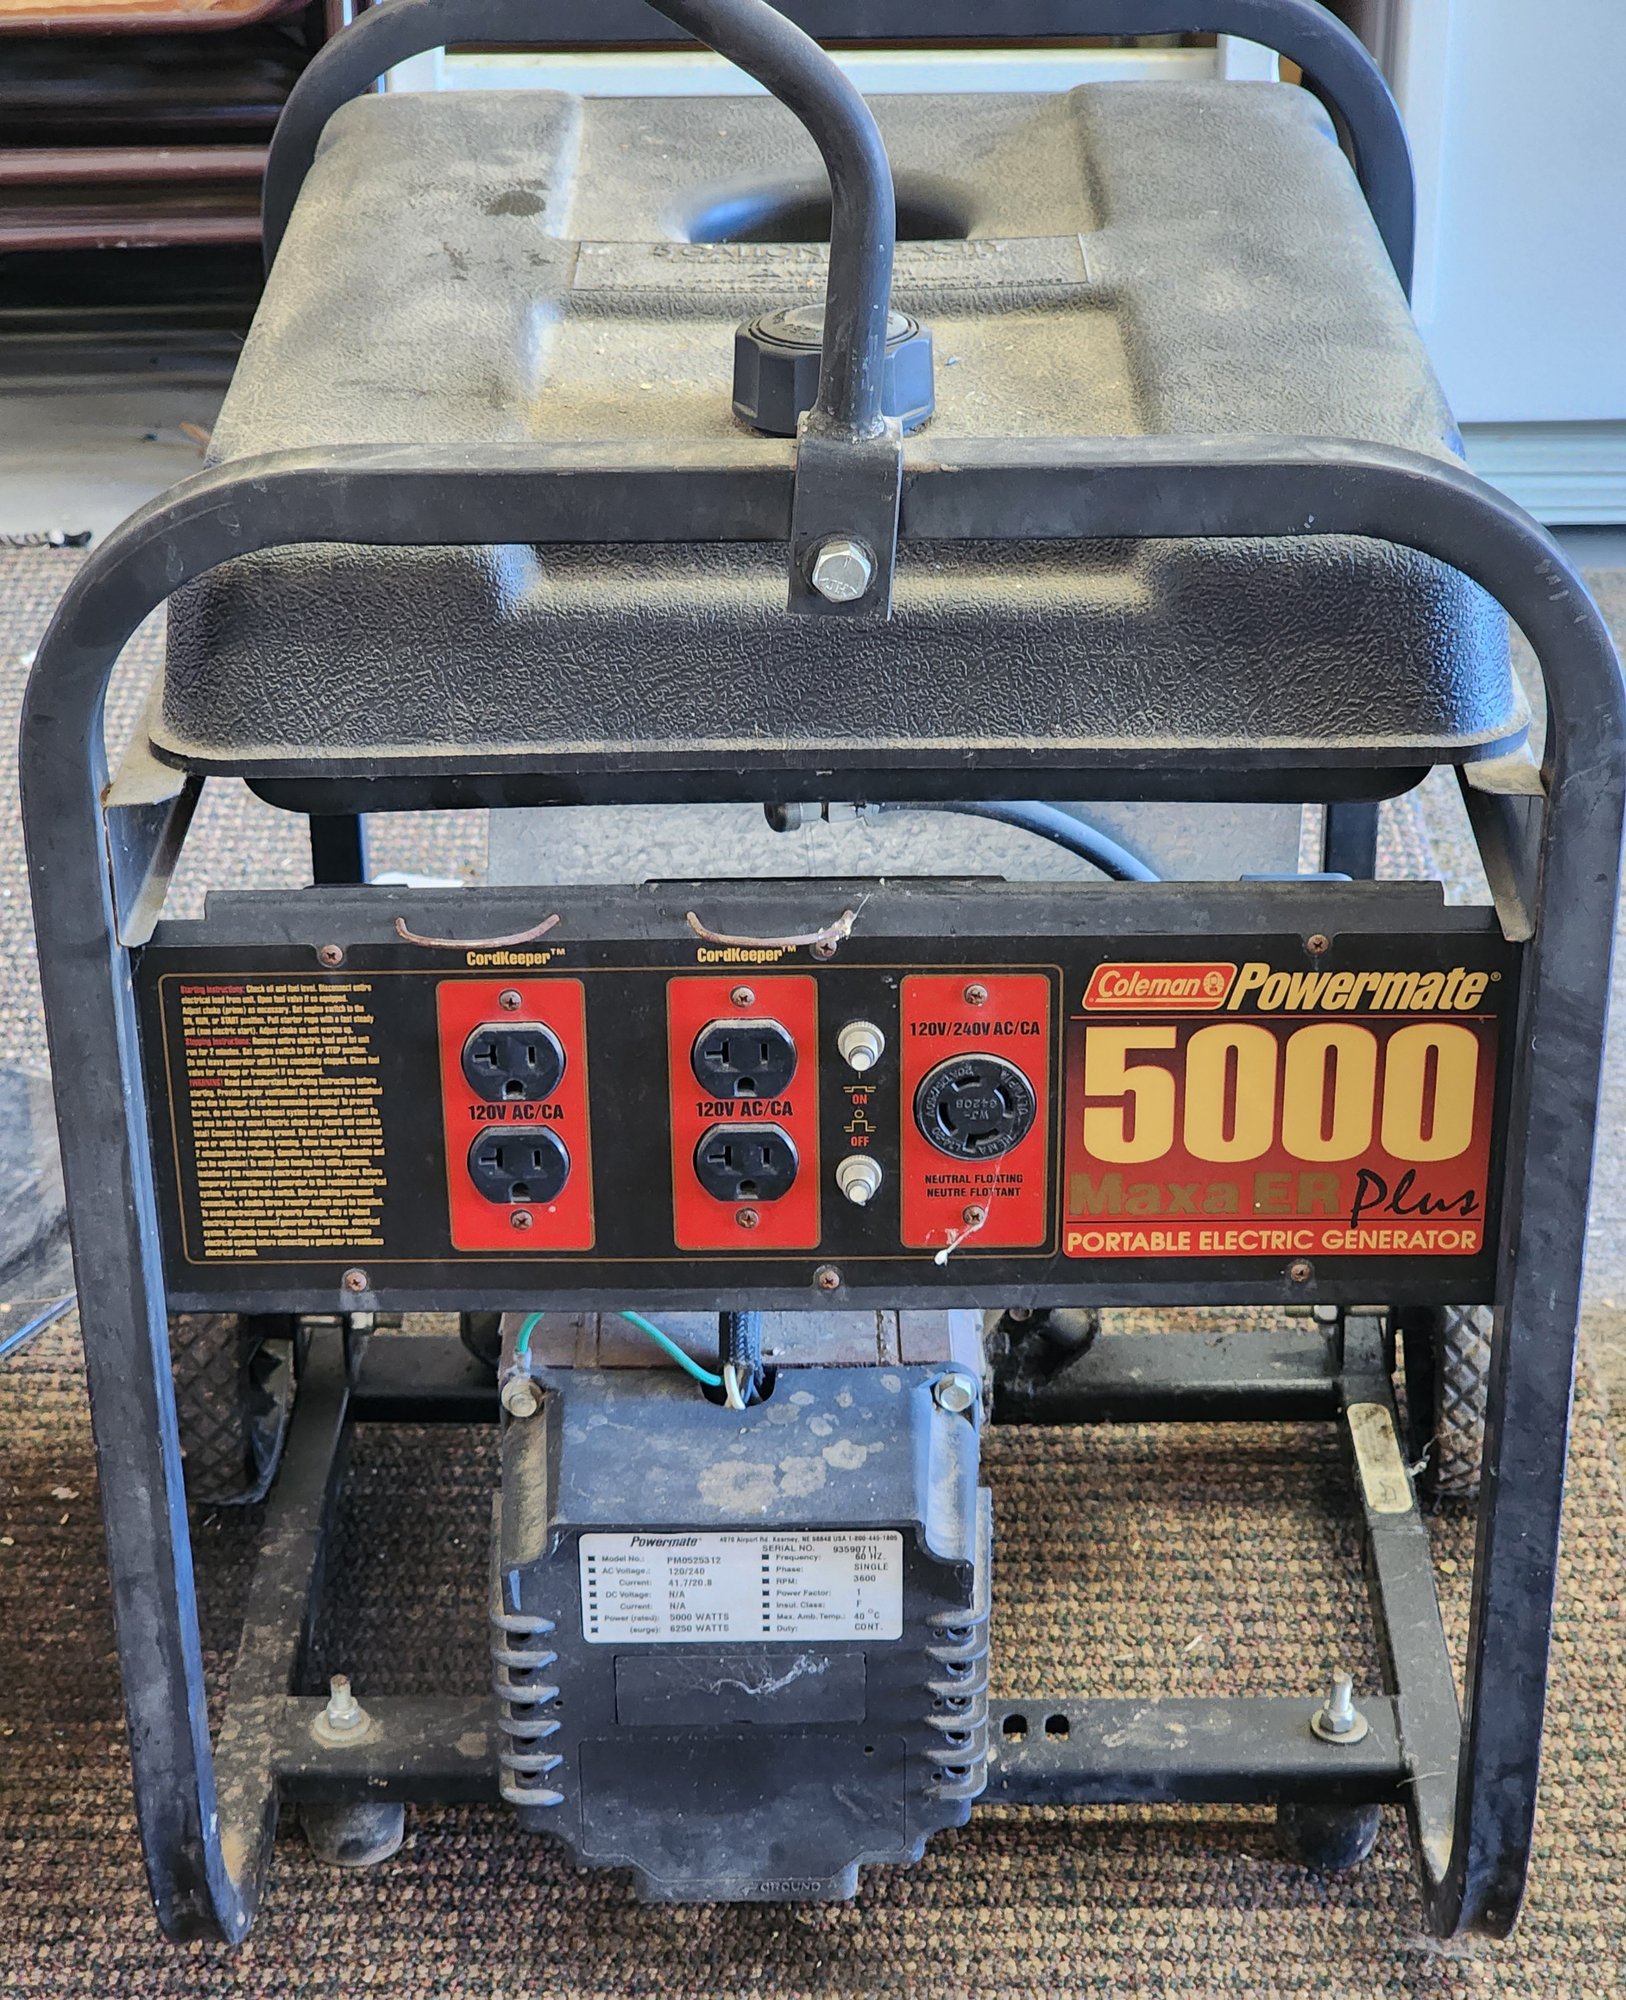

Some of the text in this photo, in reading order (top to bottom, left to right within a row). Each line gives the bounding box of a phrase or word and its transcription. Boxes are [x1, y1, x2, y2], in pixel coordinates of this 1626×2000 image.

[1098, 970, 1201, 998] Coleman
[910, 1020, 1040, 1037] 120V/240V AC/CA
[1084, 1023, 1480, 1164] 5000
[852, 1094, 868, 1105] ON
[468, 1104, 564, 1121] 120V AC/CA
[696, 1101, 794, 1118] 120V AC/CA
[851, 1136, 870, 1147] OFF
[924, 1173, 1023, 1184] NEUTRAL FLOATING
[926, 1186, 1021, 1198] NEUTRE FLOTTANT
[1350, 1168, 1480, 1229] Plus
[1067, 1229, 1477, 1252] PORTABLE ELECTRIC GENERATOR
[762, 1544, 815, 1552] SERIAL NO.
[602, 1567, 614, 1575] AC
[668, 1567, 705, 1576] 120/240
[854, 1562, 889, 1571] SINGLE
[669, 1590, 685, 1599] N/A
[669, 1602, 687, 1610] N/A
[670, 1613, 730, 1621] 5000 WATTS
[854, 1612, 865, 1620] 40
[670, 1624, 730, 1632] 6250 WATTS
[776, 1625, 798, 1633] Duty:
[854, 1623, 884, 1631] CONT.
